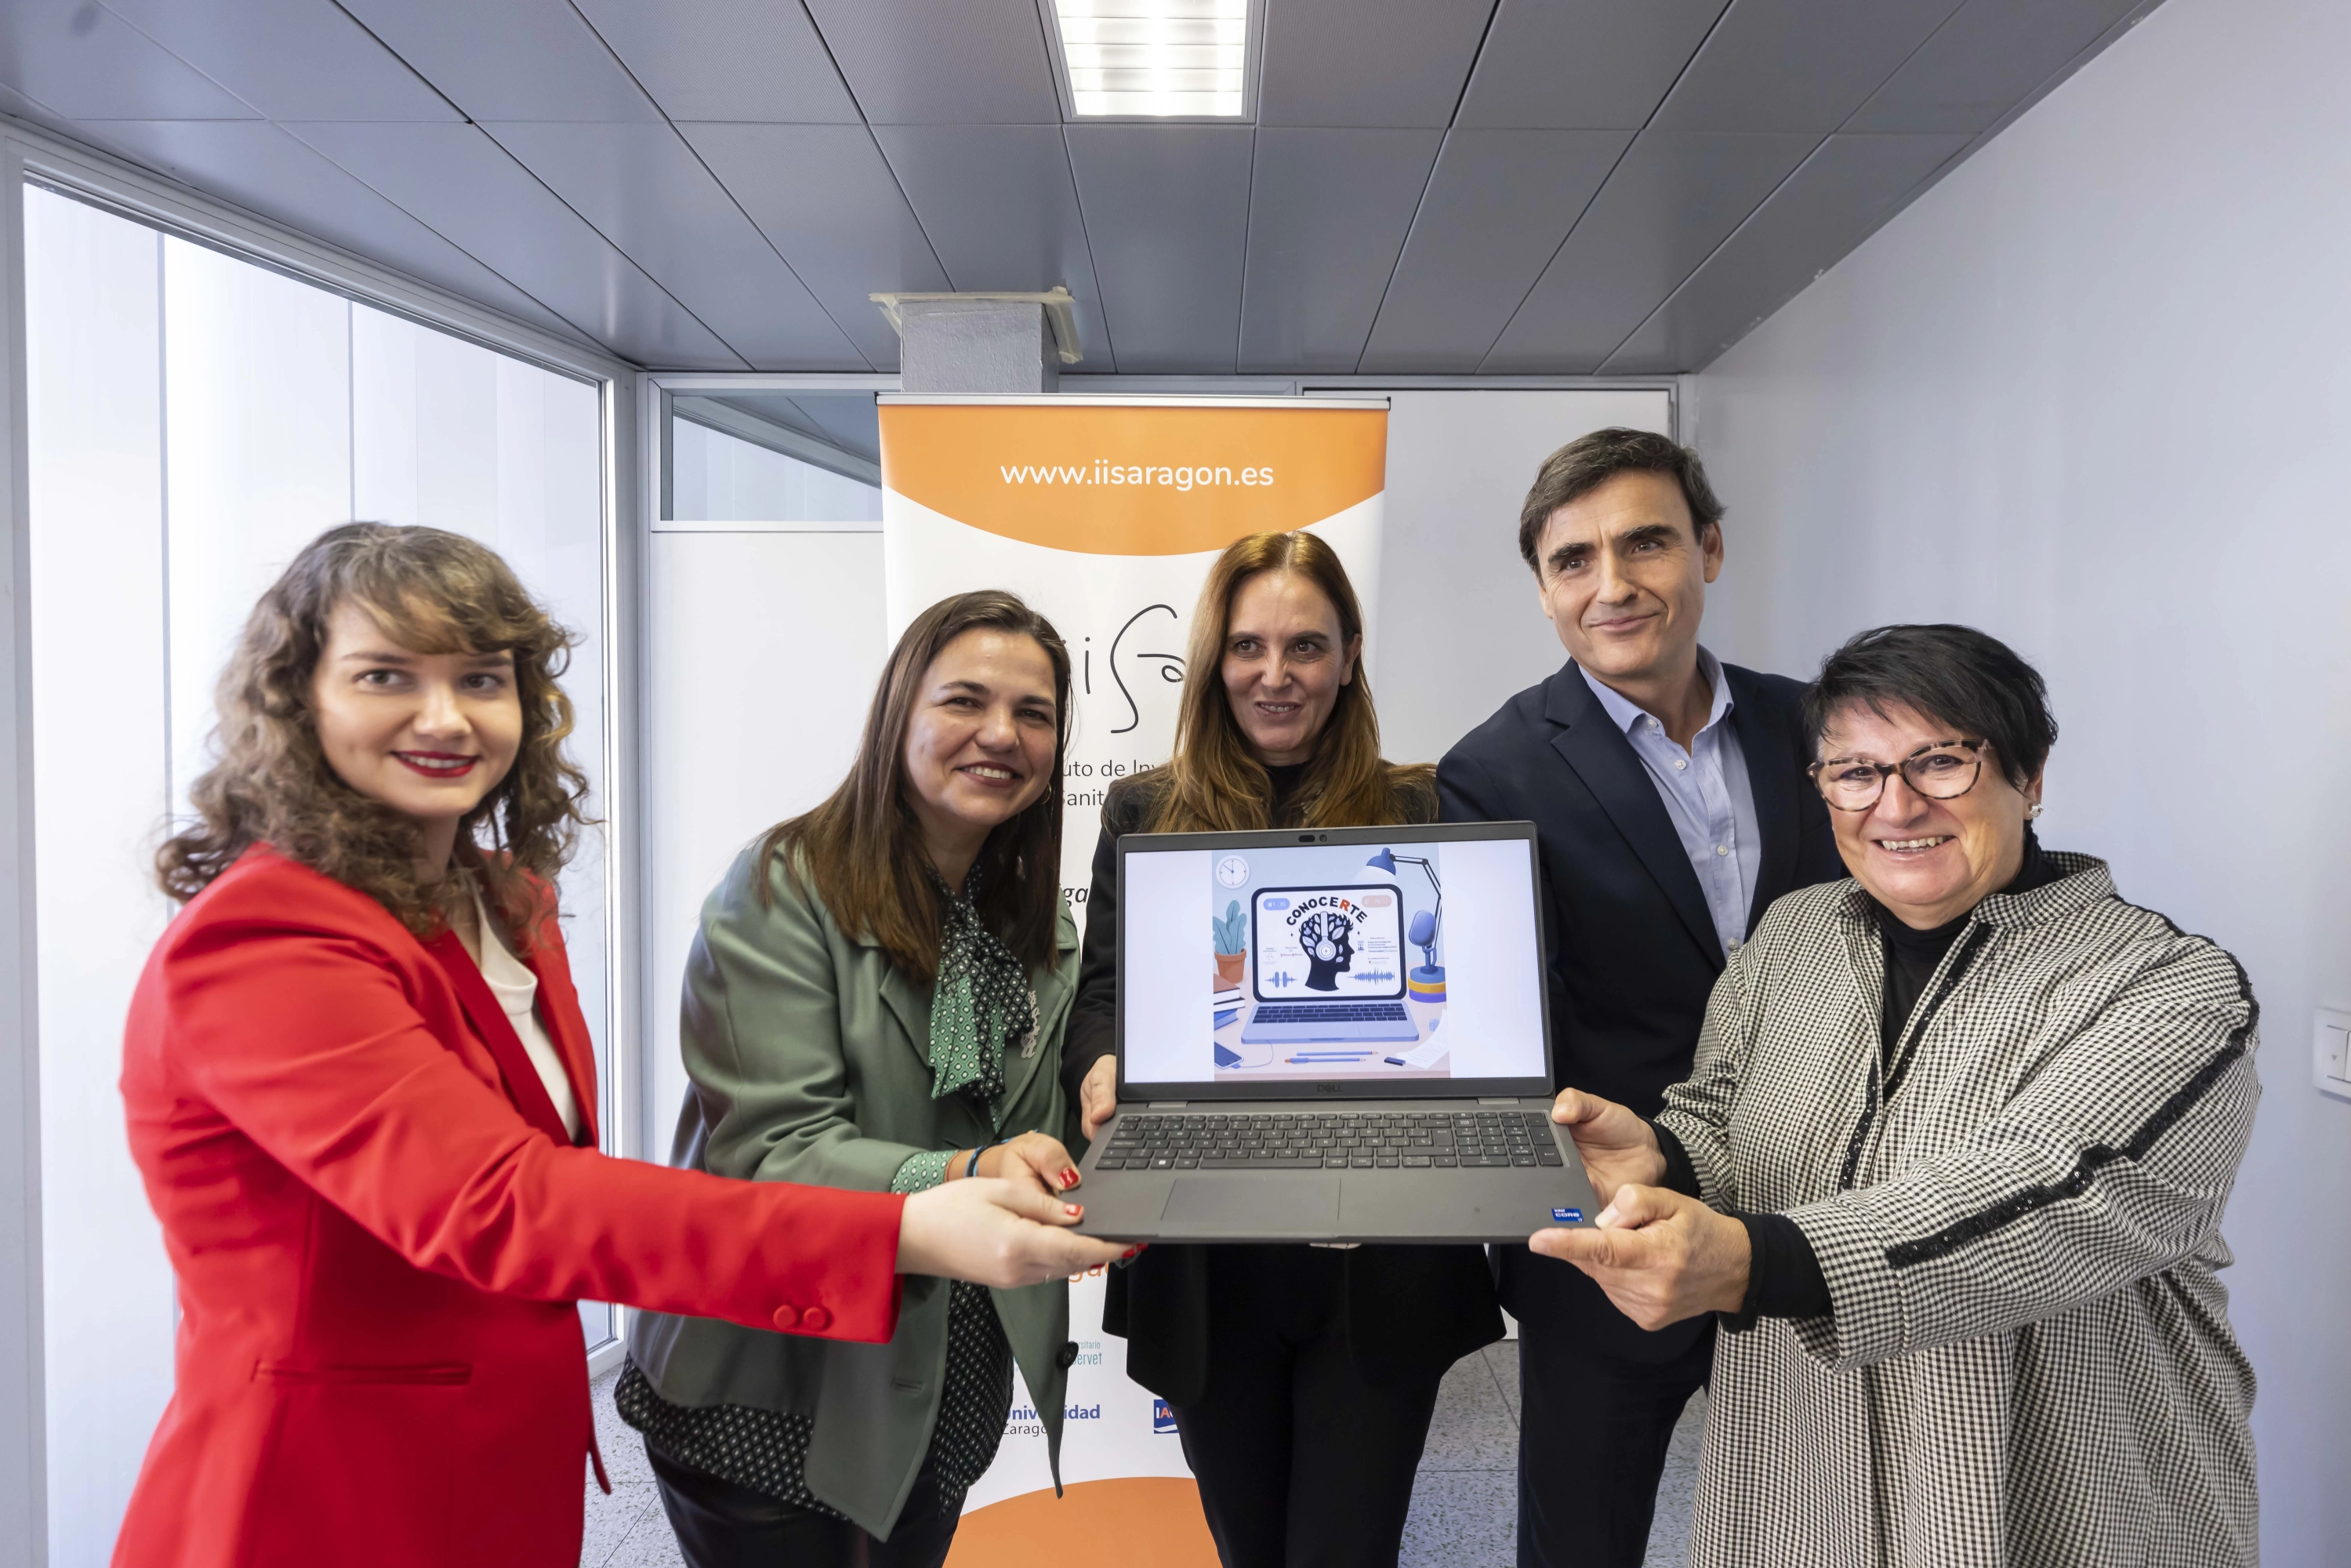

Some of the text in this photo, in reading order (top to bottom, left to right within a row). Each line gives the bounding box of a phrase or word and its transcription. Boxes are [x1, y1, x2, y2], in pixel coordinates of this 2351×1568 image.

[1000, 459, 1275, 492] www.iisaragon.es
[1101, 759, 1126, 777] de
[1063, 789, 1105, 806] anit
[1286, 896, 1368, 926] CONOCERTE
[1318, 1083, 1344, 1093] DELL
[1072, 1352, 1102, 1365] ervet
[1156, 1406, 1174, 1419] IA
